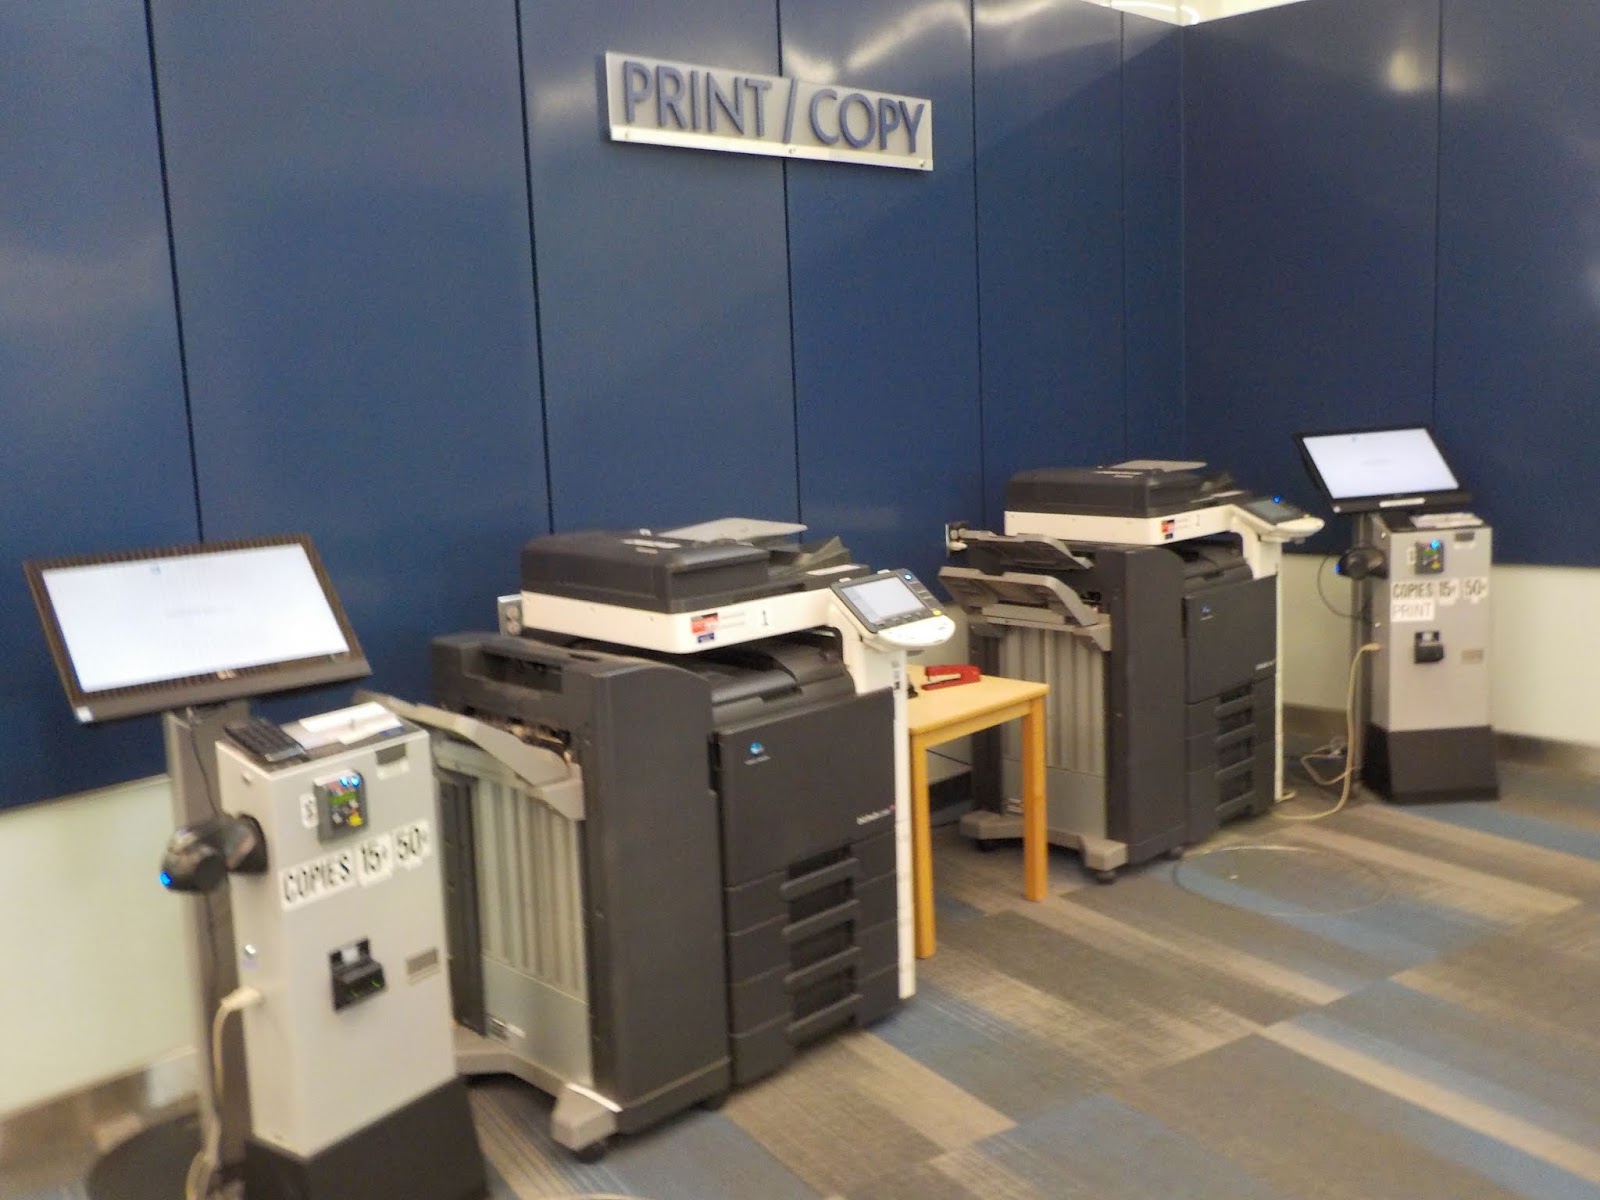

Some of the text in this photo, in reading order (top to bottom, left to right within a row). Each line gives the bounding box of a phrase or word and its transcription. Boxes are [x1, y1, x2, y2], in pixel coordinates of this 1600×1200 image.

[622, 60, 773, 138] PRINT
[808, 88, 926, 153] COPY
[1392, 582, 1434, 599] COPIES
[283, 854, 351, 902] COPIES
